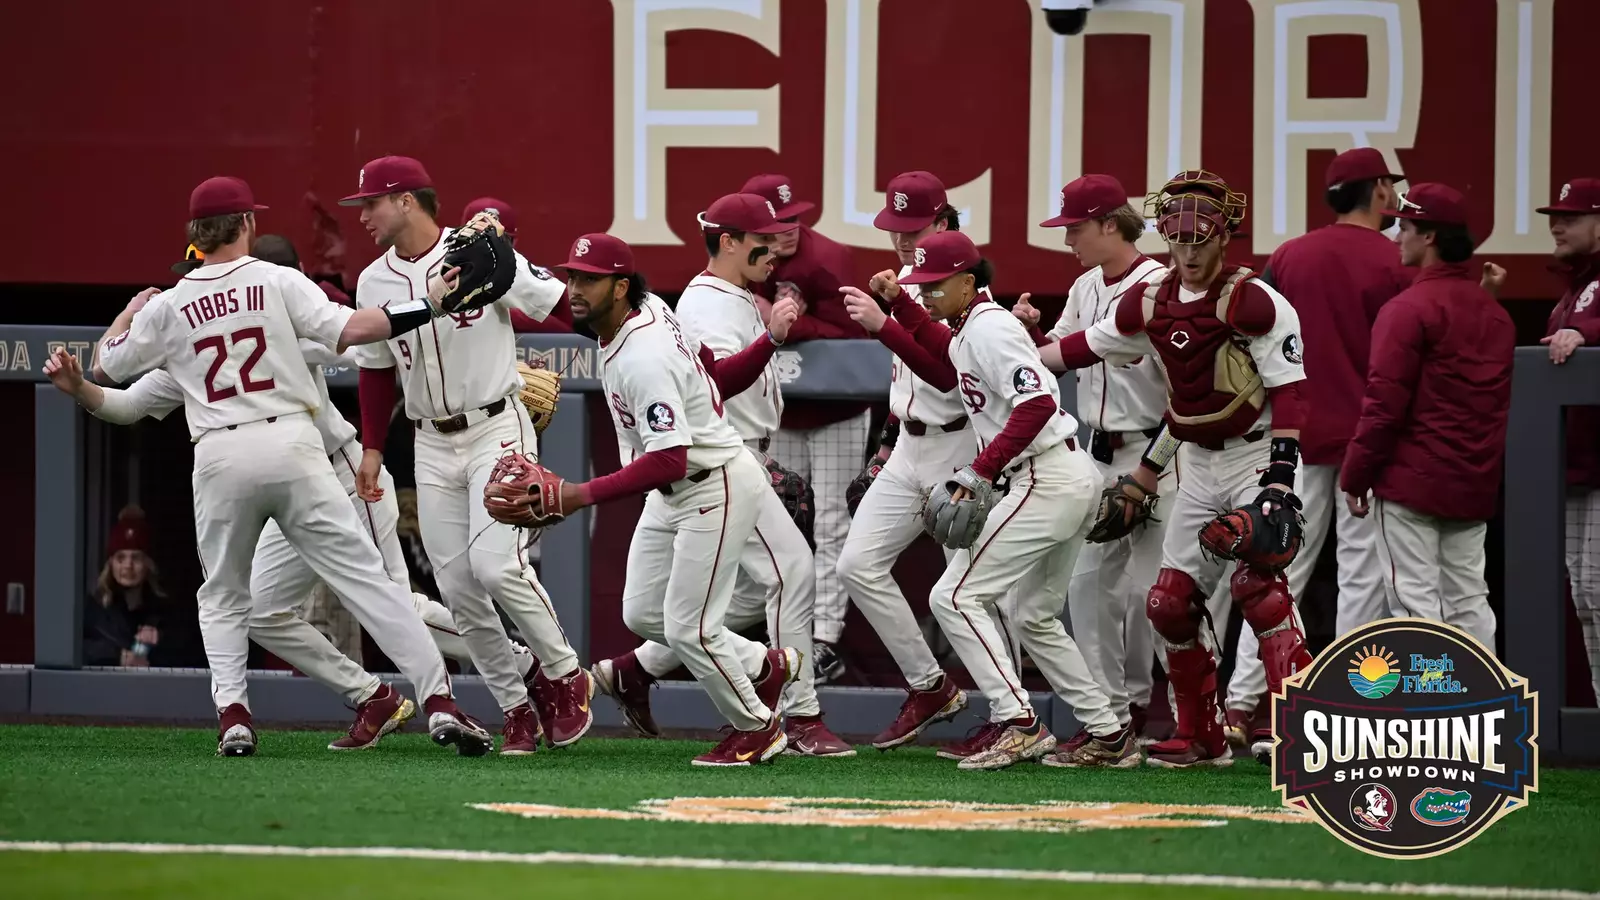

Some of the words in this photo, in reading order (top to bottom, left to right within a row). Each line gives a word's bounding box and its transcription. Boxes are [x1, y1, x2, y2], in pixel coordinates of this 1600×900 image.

[180, 287, 240, 330] TIBBS
[246, 285, 265, 311] III
[193, 326, 276, 404] 22
[398, 340, 412, 370] 9
